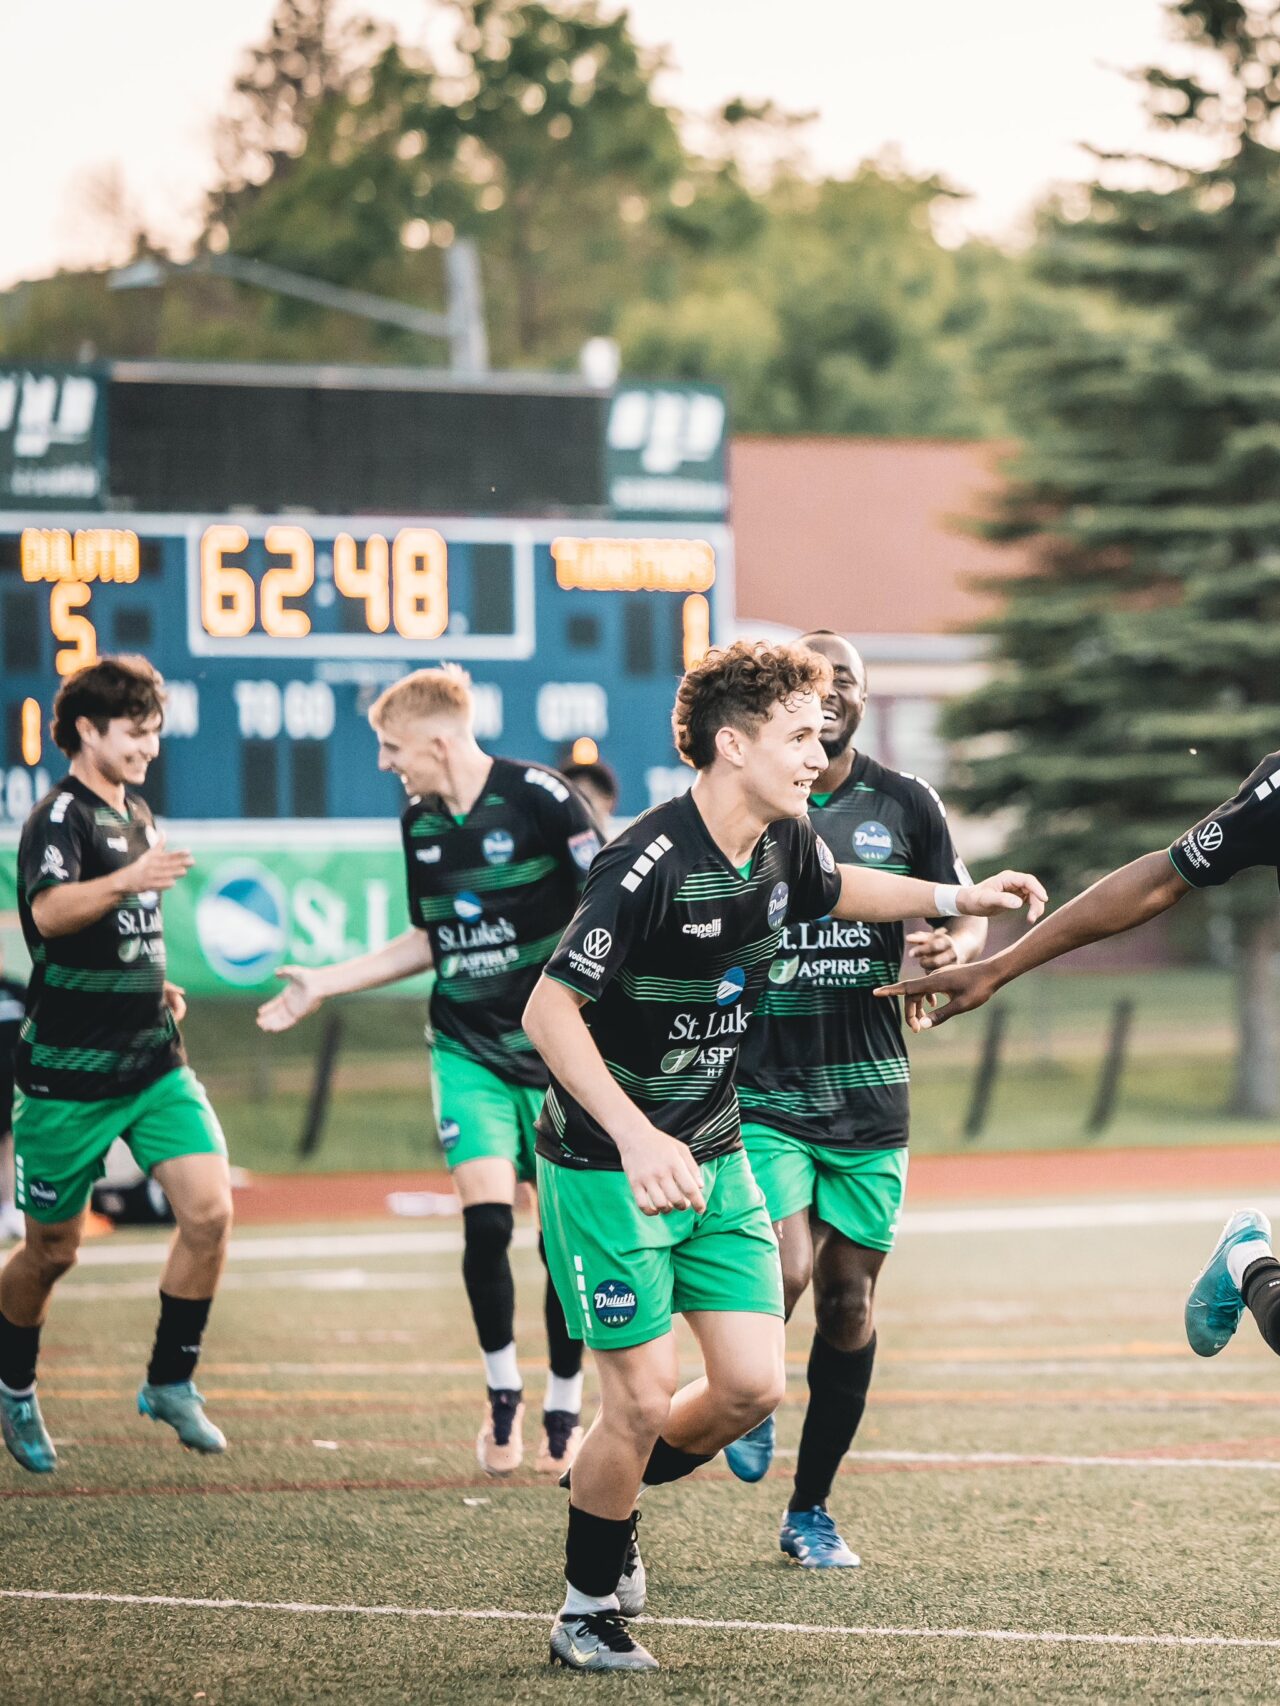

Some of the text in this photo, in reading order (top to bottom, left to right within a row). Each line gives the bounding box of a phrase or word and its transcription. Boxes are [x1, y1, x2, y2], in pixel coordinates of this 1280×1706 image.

[50, 580, 97, 676] 5
[1183, 845, 1200, 869] Duluth
[682, 918, 721, 938] capelli
[799, 921, 872, 950] Luke's
[568, 949, 606, 974] Volkswage
[798, 958, 872, 978] ASPIRUS
[577, 963, 601, 981] Duluth
[812, 978, 857, 986] HEALTH
[668, 1003, 753, 1041] St. Luk
[693, 1046, 737, 1066] ASP
[594, 1292, 636, 1309] Duluth
